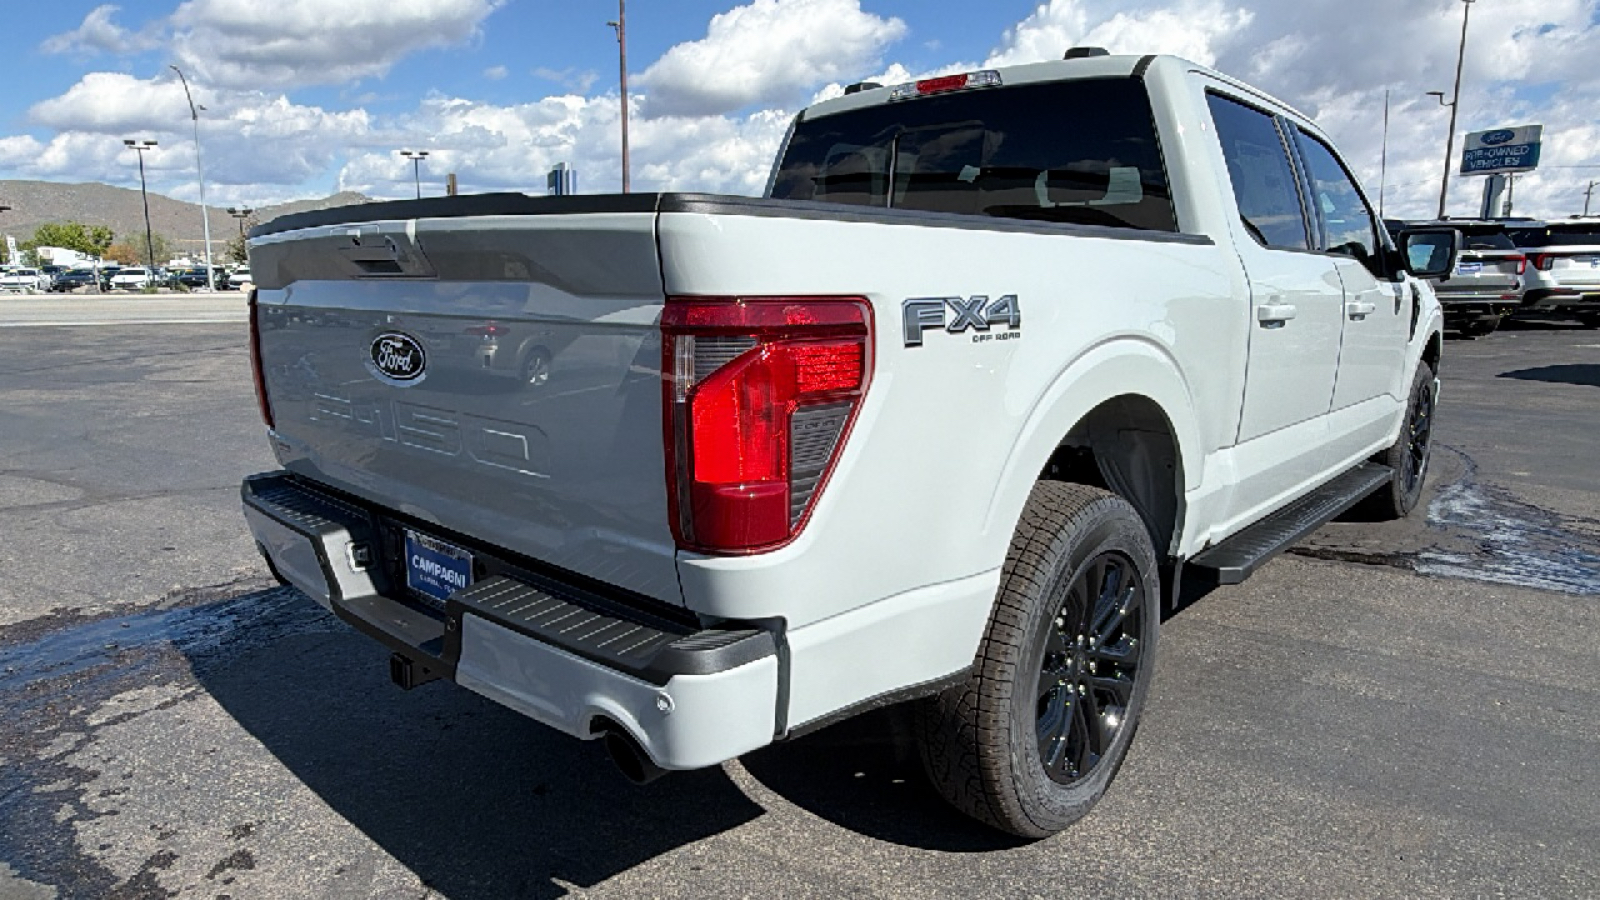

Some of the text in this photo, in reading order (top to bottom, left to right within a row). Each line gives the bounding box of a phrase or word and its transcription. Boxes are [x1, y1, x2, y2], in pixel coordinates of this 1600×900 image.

[1464, 145, 1530, 161] PRE-OWNED
[1470, 156, 1521, 168] VEHICLES
[901, 294, 1021, 348] FX4
[972, 332, 1021, 343] OFF ROAD
[378, 339, 413, 371] Ford
[412, 554, 466, 589] CAMPAGNI
